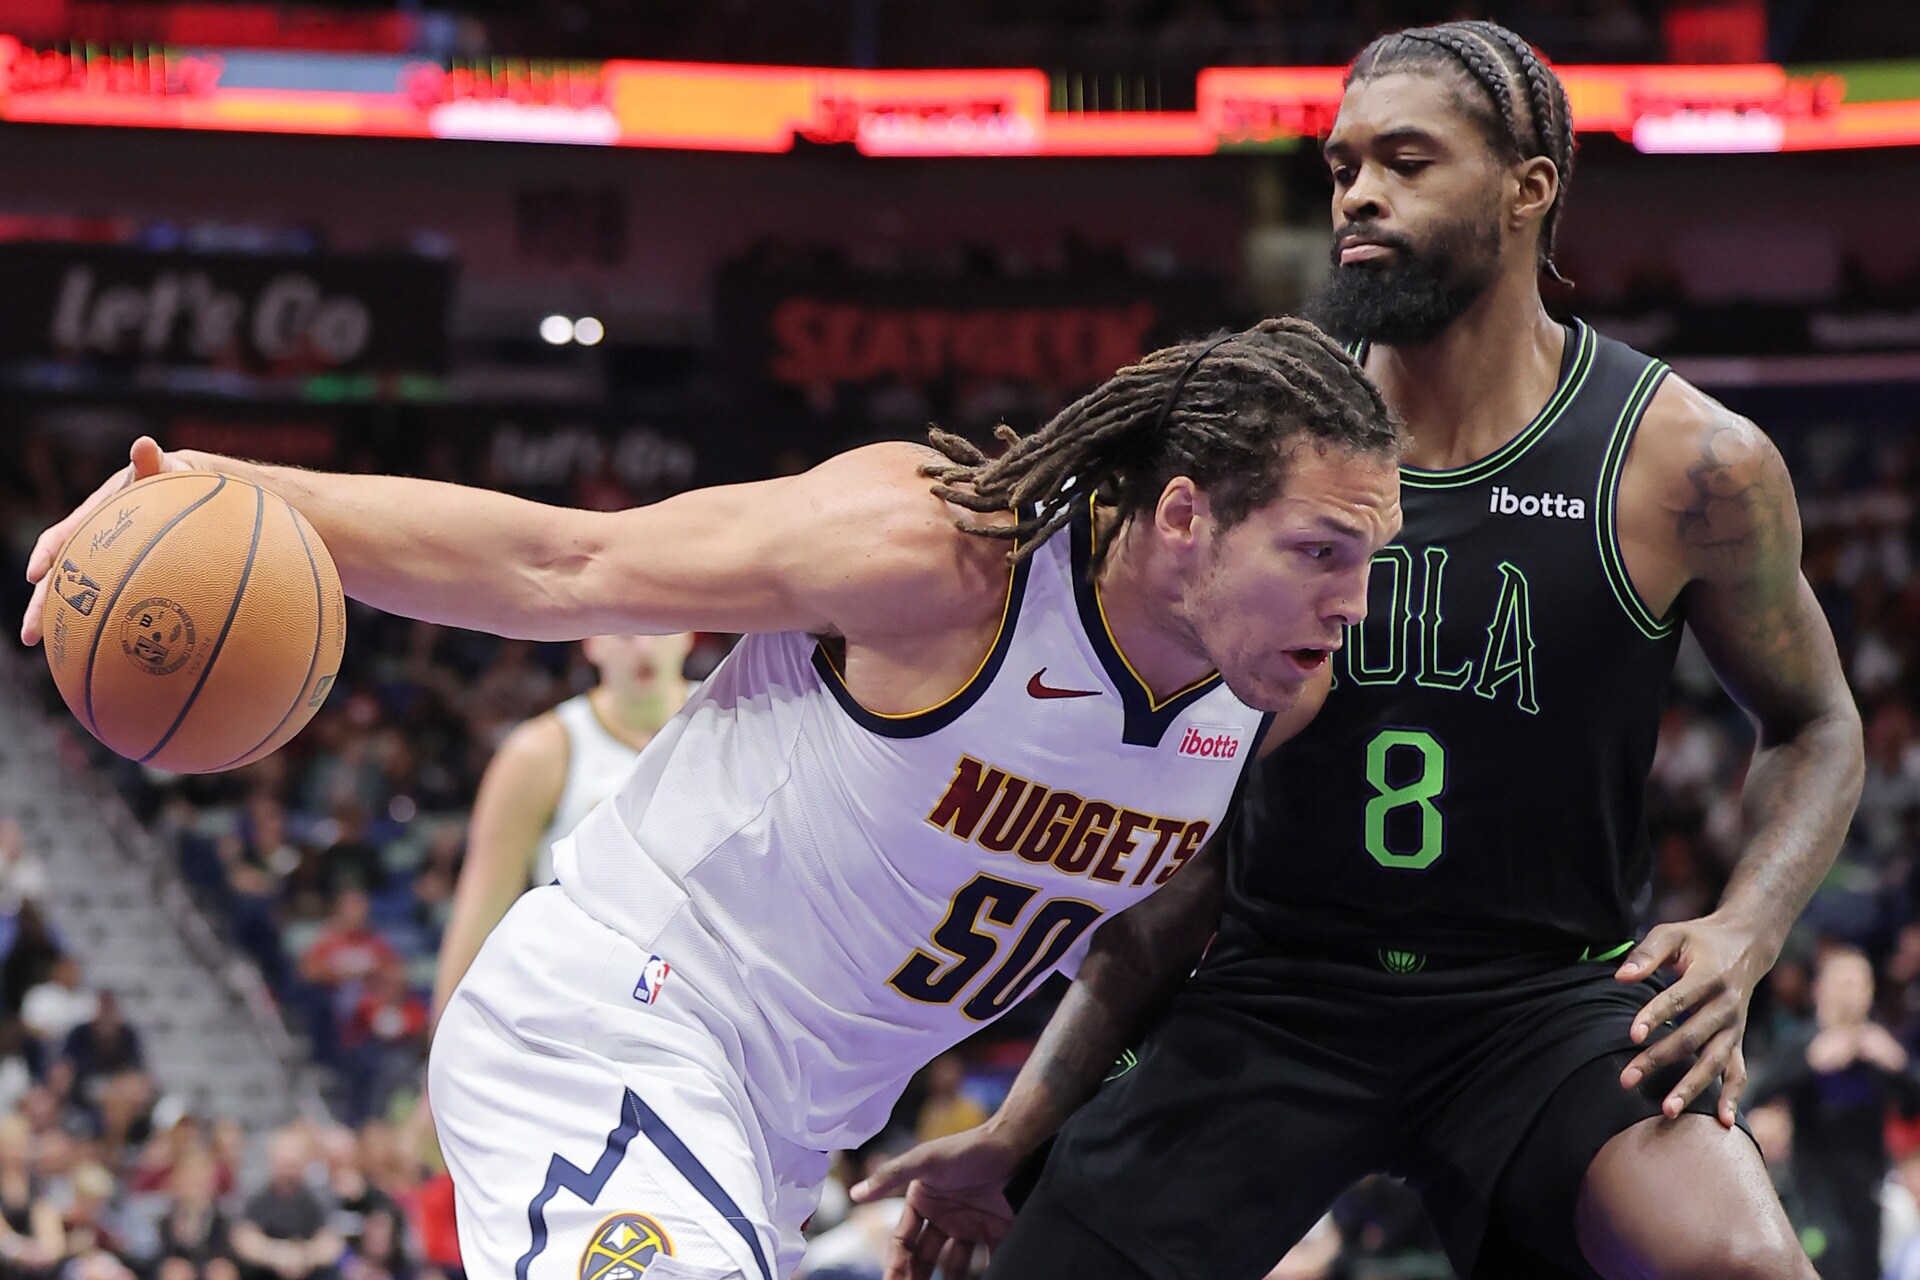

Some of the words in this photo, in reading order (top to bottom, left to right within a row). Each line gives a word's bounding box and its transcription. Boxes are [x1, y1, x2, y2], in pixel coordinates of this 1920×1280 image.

[252, 273, 372, 364] Go
[1490, 486, 1585, 520] ibotta
[1329, 545, 1540, 715] OLA
[1179, 727, 1239, 759] ibotta
[1365, 729, 1445, 870] 8
[925, 754, 1211, 888] NUGGETS
[884, 871, 1110, 1022] 50
